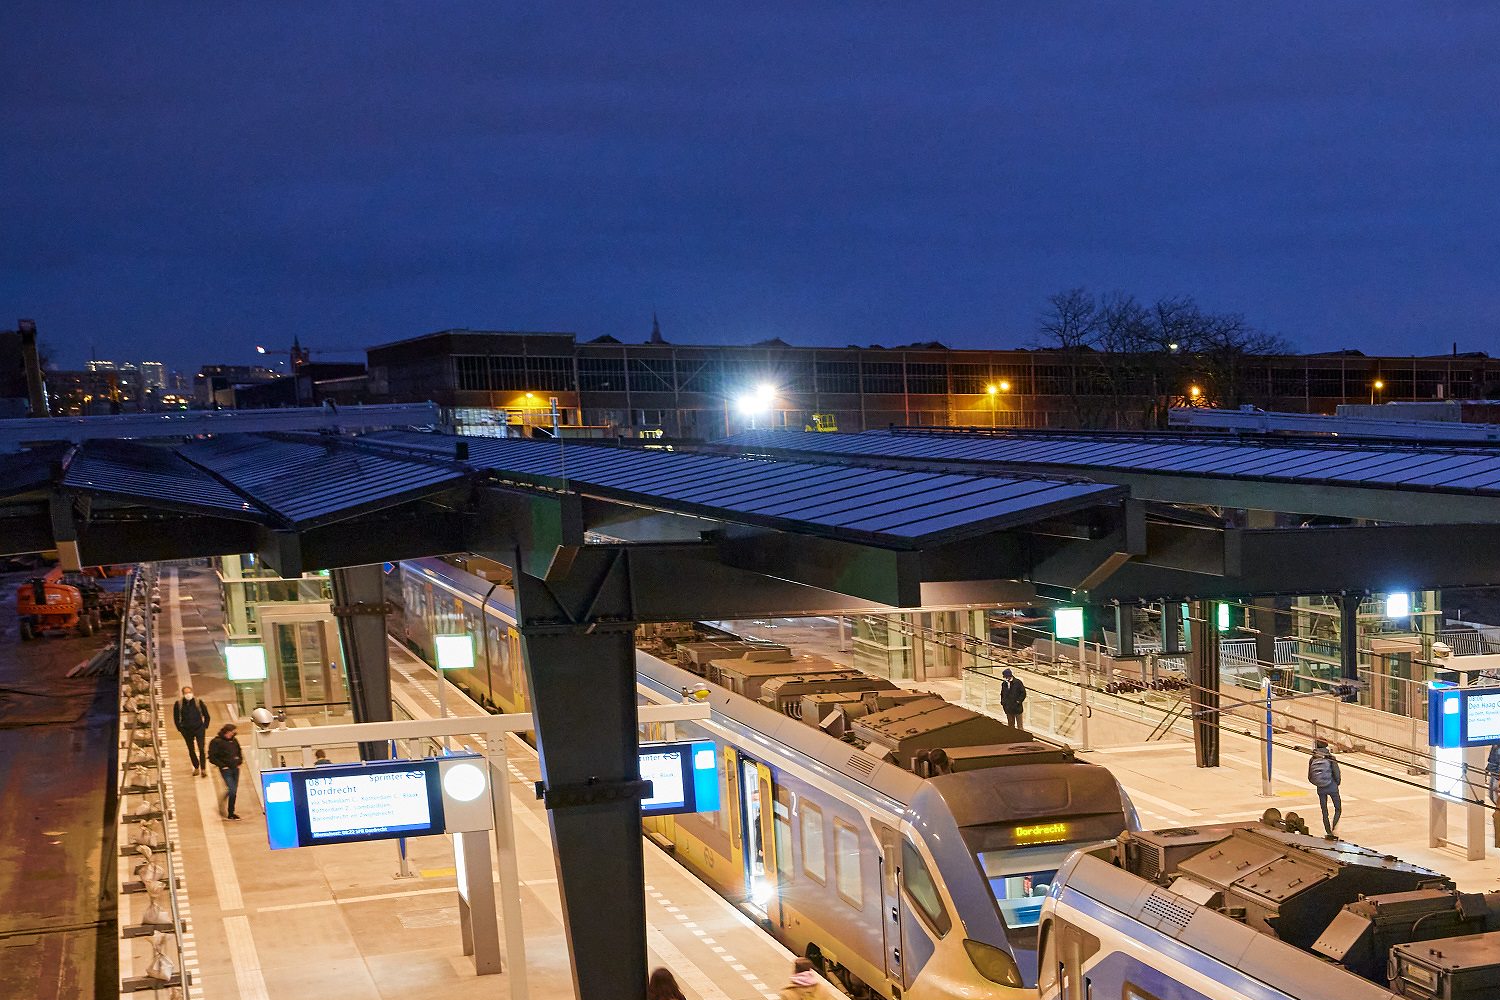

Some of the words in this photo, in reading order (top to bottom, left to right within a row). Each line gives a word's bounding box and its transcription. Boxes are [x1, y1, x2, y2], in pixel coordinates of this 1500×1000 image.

[308, 778, 333, 787] 0812
[369, 773, 403, 783] Sprinter
[310, 785, 357, 796] Dordrecht
[791, 791, 798, 817] 2
[1015, 824, 1067, 837] Dordrecht
